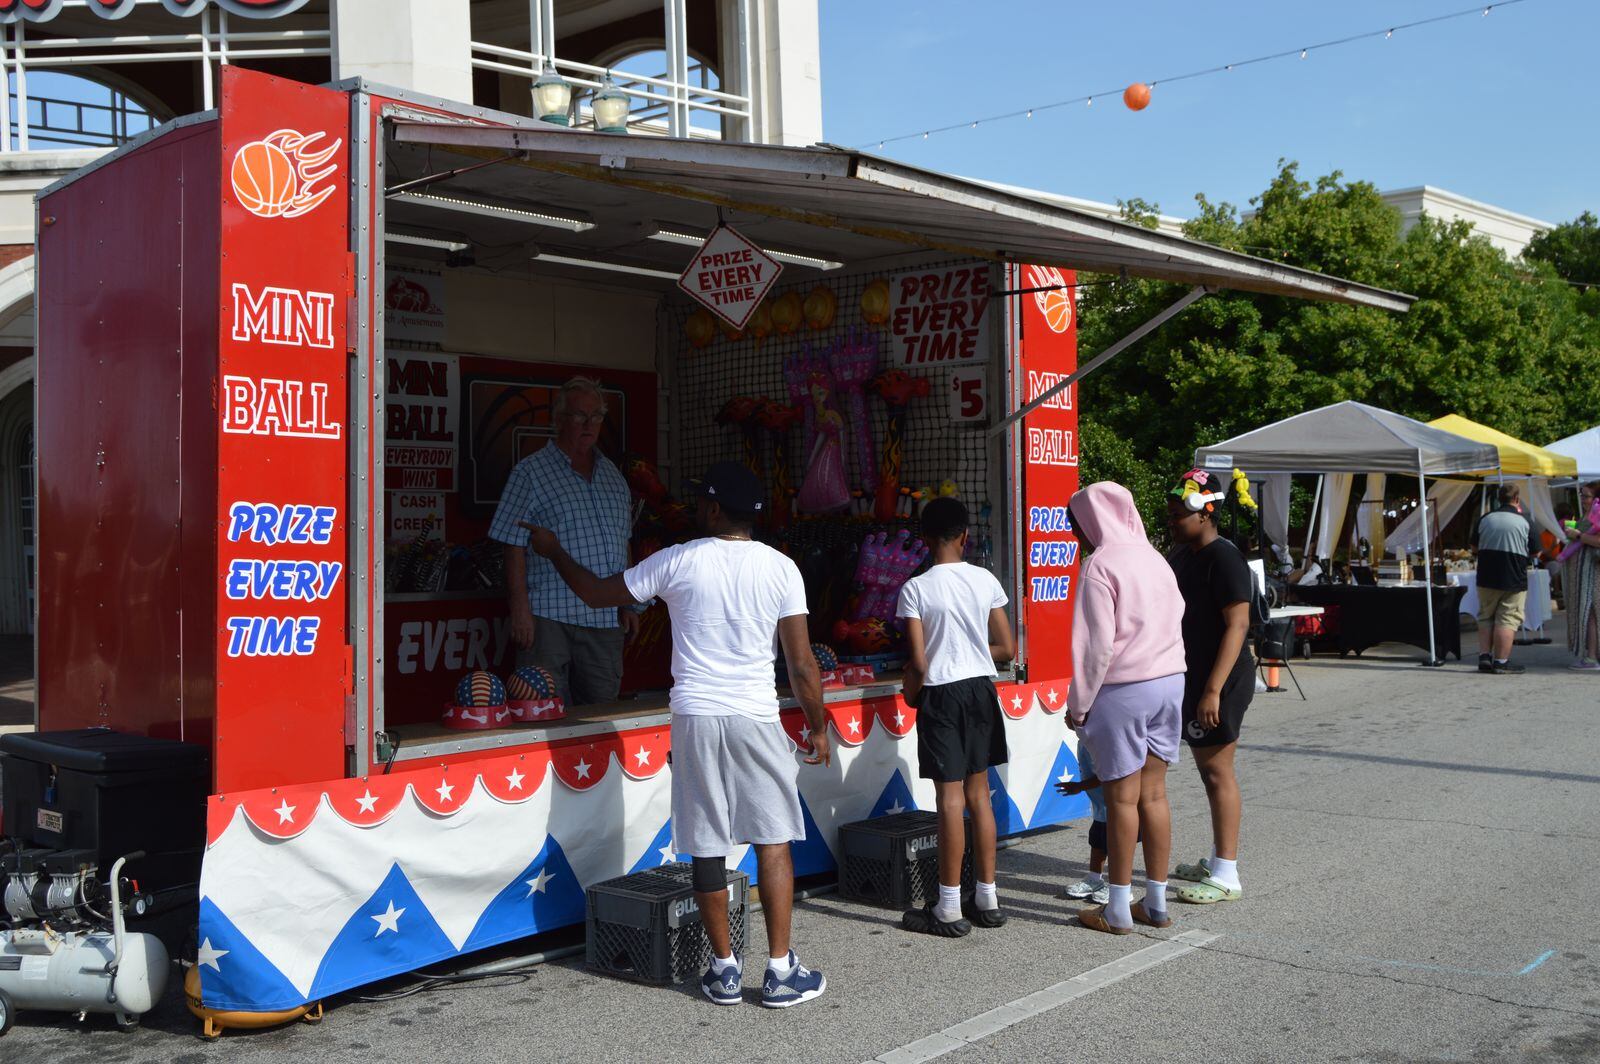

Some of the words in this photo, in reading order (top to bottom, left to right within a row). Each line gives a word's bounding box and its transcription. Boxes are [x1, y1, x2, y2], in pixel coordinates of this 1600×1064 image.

[697, 263, 763, 291] EVERY
[700, 249, 754, 269] PRIZE
[711, 287, 756, 306] TIME
[899, 266, 989, 305] PRIZE
[232, 283, 334, 349] MINI
[893, 297, 990, 336] EVERY
[902, 329, 979, 365] TIME
[387, 358, 448, 398] MINI
[952, 376, 984, 418] $5
[1028, 370, 1072, 410] MINI
[223, 375, 340, 440] BALL
[386, 404, 453, 442] BALL
[386, 447, 452, 466] EVERYBODY
[1028, 428, 1078, 467] BALL
[403, 469, 437, 488] WINS
[400, 495, 437, 508] CASH
[227, 501, 337, 547] PRIZE
[1030, 541, 1079, 568] EVERY
[226, 559, 342, 603] EVERY
[1031, 576, 1070, 602] TIME
[227, 616, 321, 658] TIME
[397, 617, 512, 675] EVERY
